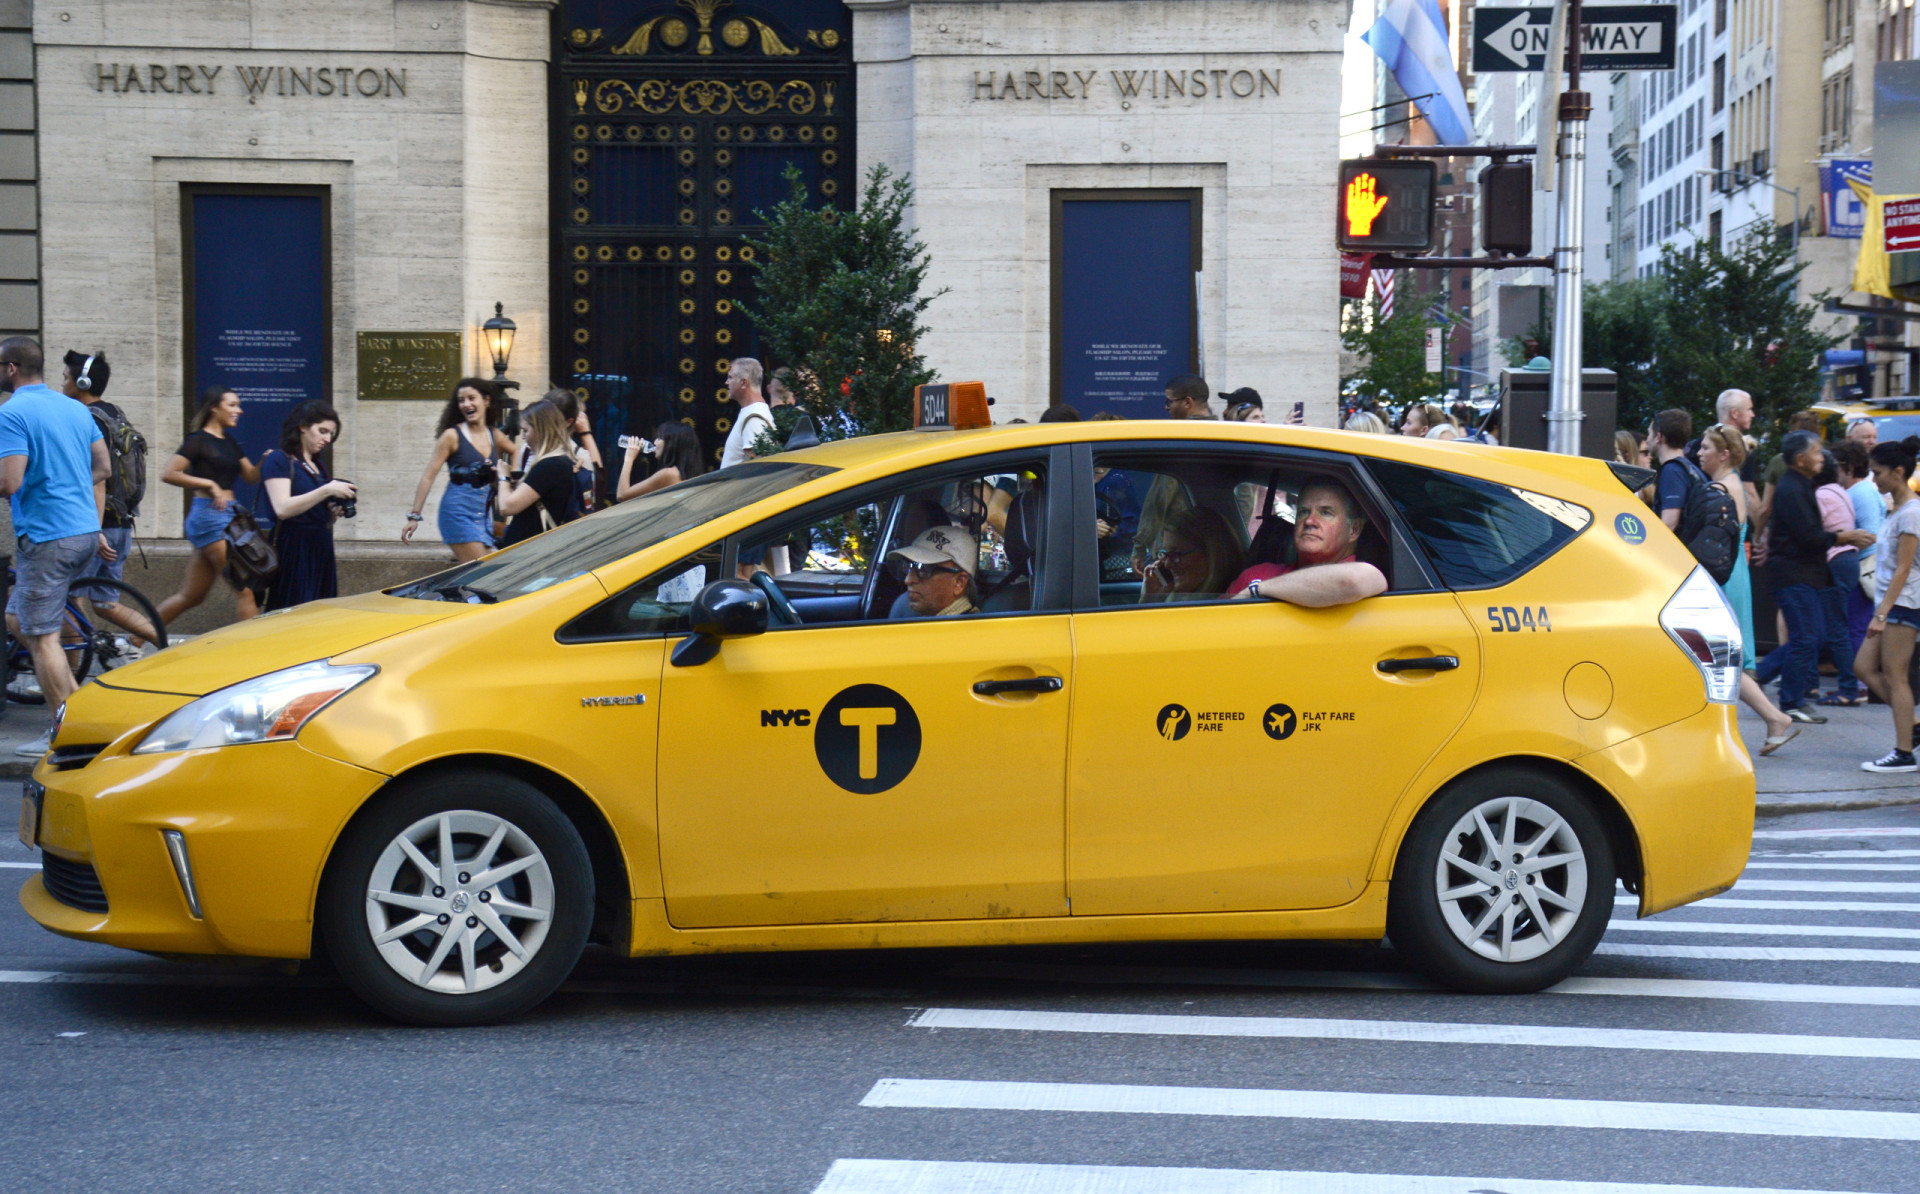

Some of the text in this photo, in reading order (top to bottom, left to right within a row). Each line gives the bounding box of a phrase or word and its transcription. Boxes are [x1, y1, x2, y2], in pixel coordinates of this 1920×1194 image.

[1511, 26, 1648, 52] ON WAY
[96, 63, 407, 97] HARRY WINSTON
[973, 69, 1282, 100] HARRY WINSTON
[1885, 205, 1898, 216] NO
[924, 393, 946, 425] 5D44
[1487, 606, 1552, 632] 5D44
[581, 695, 636, 707] HYBRID
[1197, 712, 1245, 721] METERED
[1302, 712, 1355, 720] FLAT FARE
[1197, 723, 1223, 732] FARE
[1302, 723, 1321, 732] JFK
[760, 706, 897, 780] NYC T
